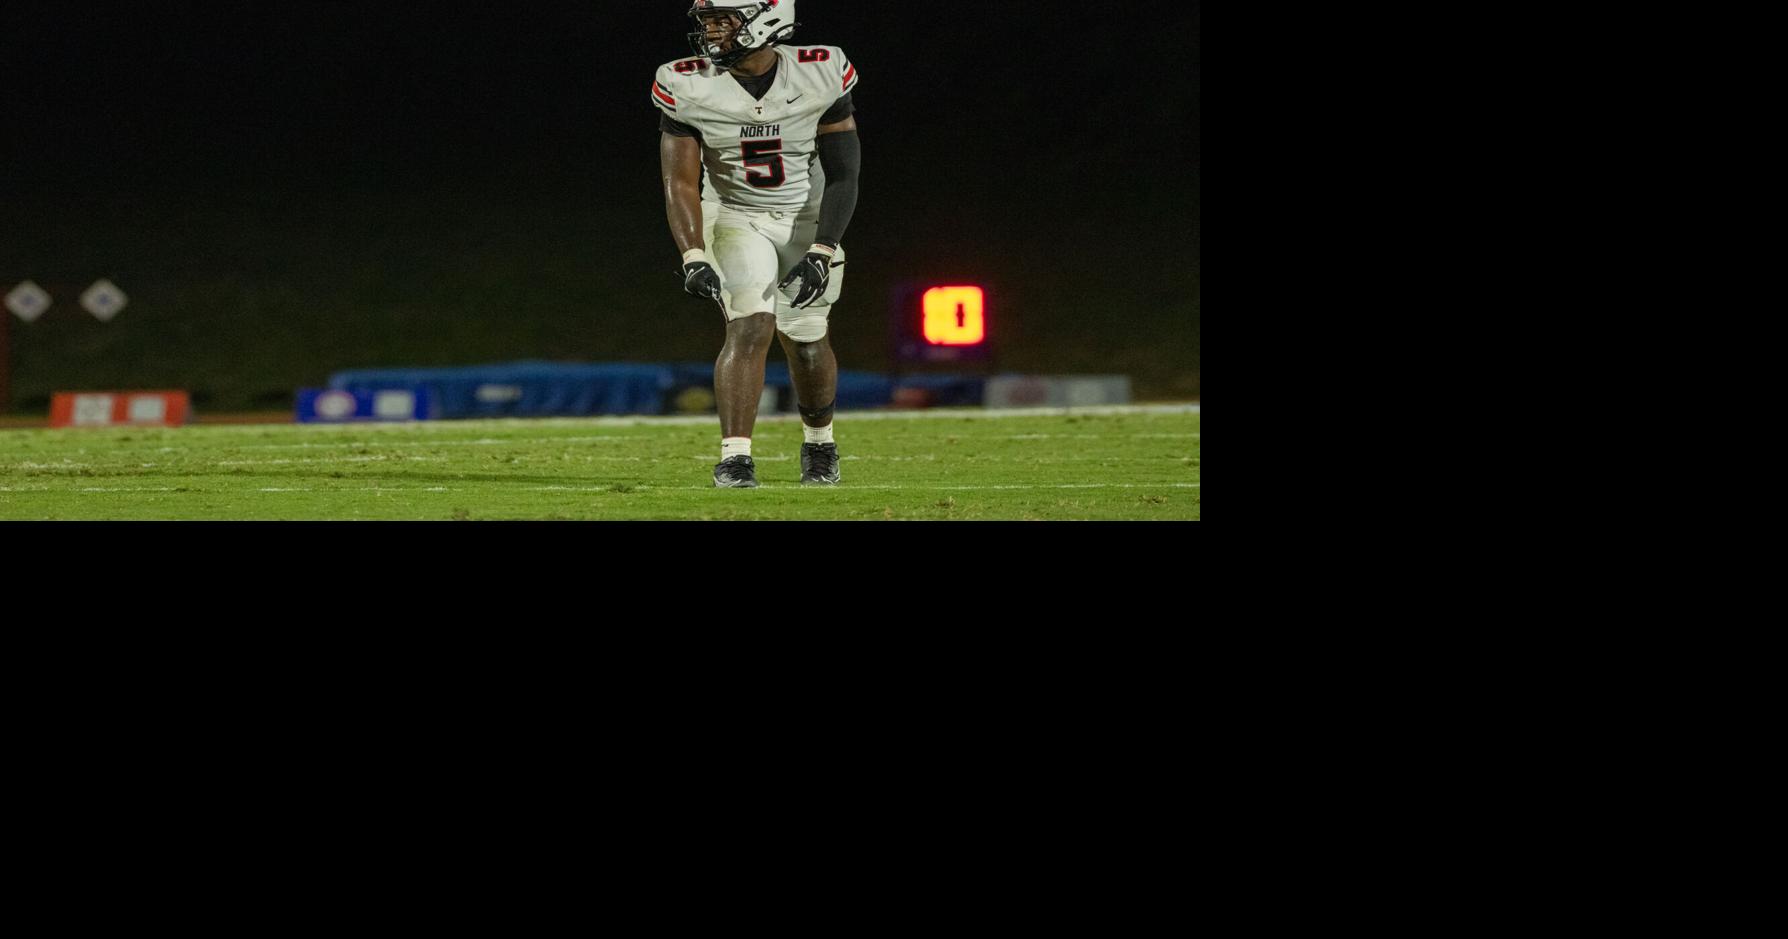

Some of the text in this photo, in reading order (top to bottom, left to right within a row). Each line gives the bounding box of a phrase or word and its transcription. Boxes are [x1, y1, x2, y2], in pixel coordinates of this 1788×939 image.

[797, 48, 830, 63] 5
[739, 124, 780, 138] NORTH
[740, 138, 786, 188] 5
